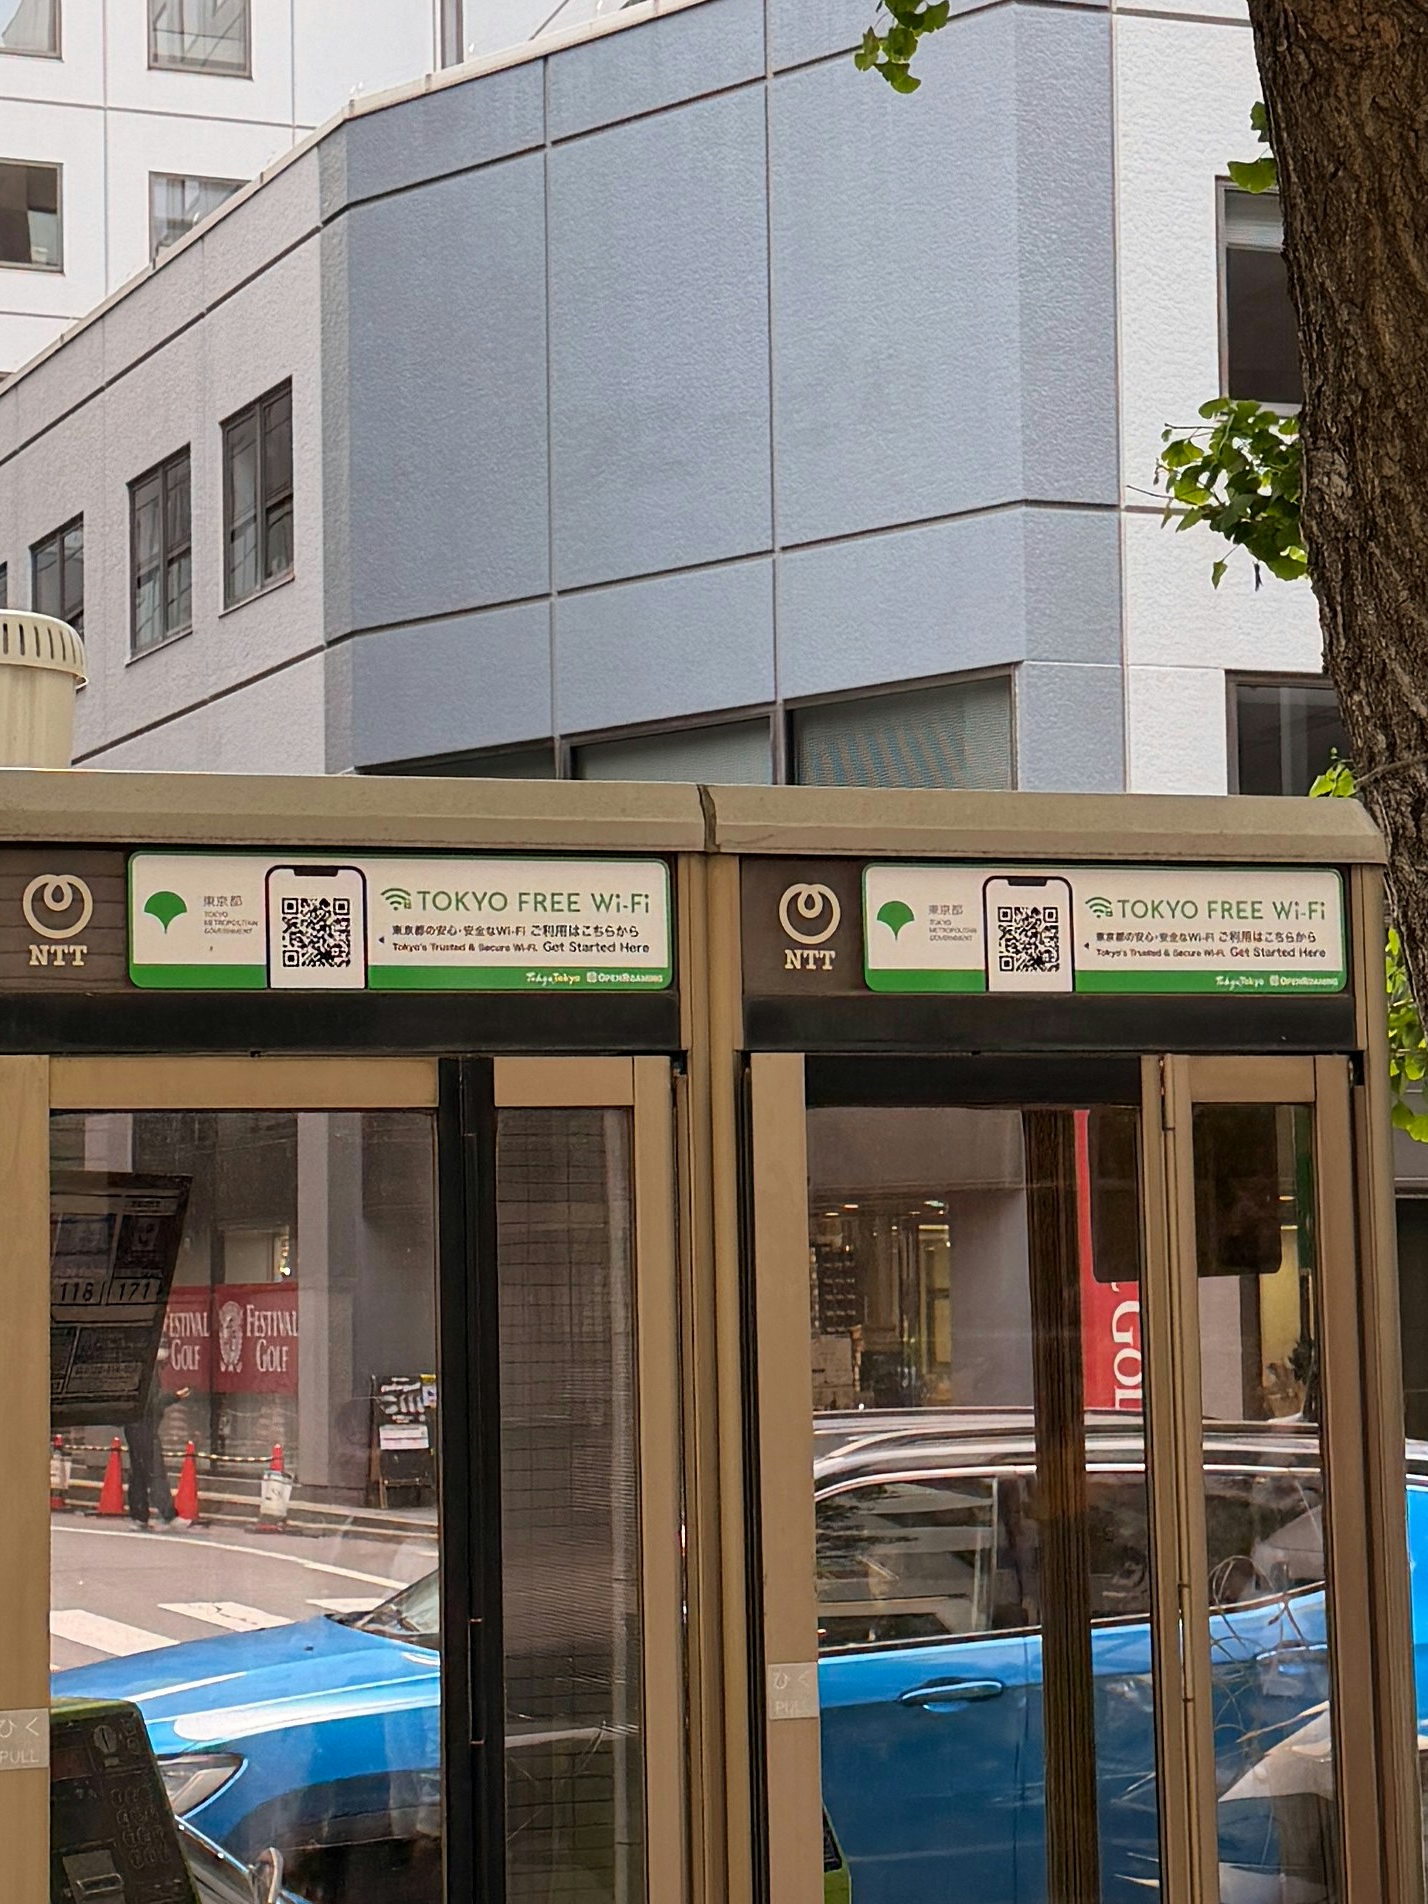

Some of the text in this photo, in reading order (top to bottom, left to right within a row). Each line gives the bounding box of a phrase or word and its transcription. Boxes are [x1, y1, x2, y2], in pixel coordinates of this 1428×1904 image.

[203, 895, 243, 907] 東京都
[417, 890, 650, 914] TOKYO FREE Wi-Fi
[928, 904, 964, 916] 東京都
[1117, 899, 1326, 921] TOKYO FREE Wi-Fi
[530, 924, 640, 938] ご利用はこちらから
[1218, 931, 1317, 944] ご利用はこちらから
[28, 944, 88, 967] NTT
[392, 942, 428, 953] Tokyo's
[429, 942, 466, 953] Trusted
[478, 943, 511, 953] Secure
[542, 941, 566, 953] Get
[569, 941, 617, 954] Started
[619, 941, 650, 954] Here
[1229, 947, 1251, 959] Get
[1254, 946, 1296, 959] Started
[1299, 947, 1327, 959] Here
[784, 949, 836, 970] NTT
[59, 1281, 150, 1302] 118 171
[245, 1303, 298, 1338] FESTIVAL
[171, 1338, 201, 1371] GOLF
[255, 1338, 290, 1373] GOLF
